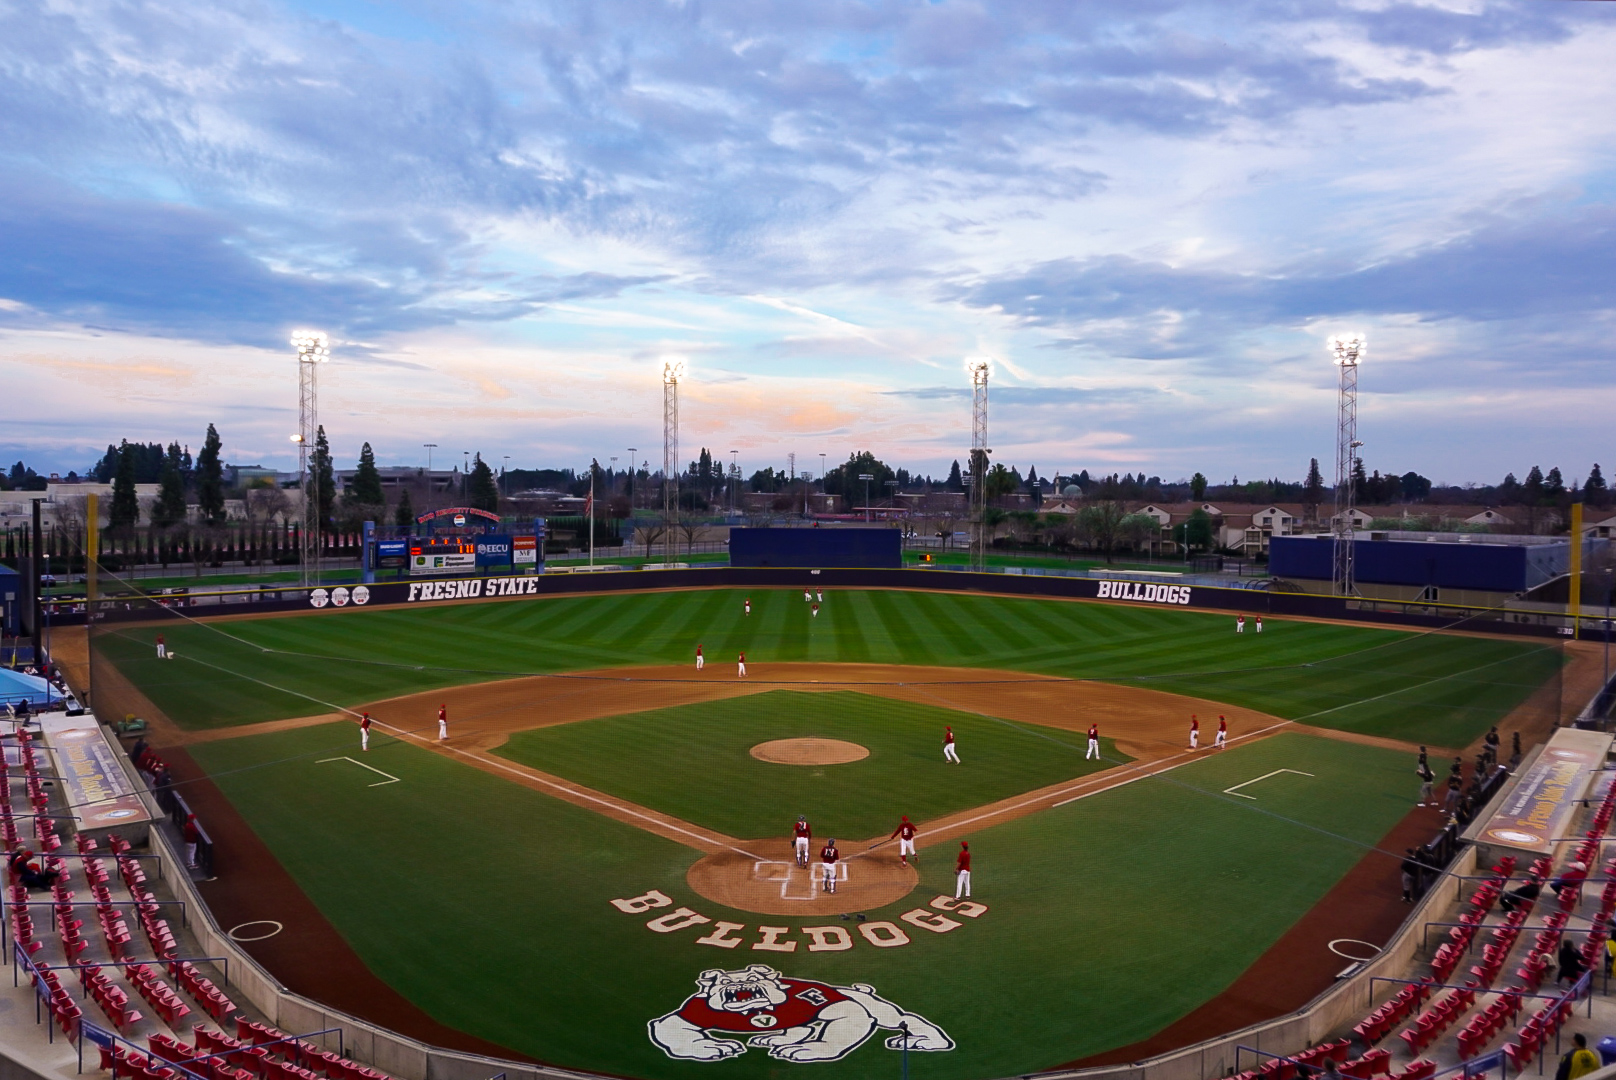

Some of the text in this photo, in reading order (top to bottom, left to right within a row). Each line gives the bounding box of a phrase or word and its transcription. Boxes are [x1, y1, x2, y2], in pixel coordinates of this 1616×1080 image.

[486, 544, 508, 553] EECU
[408, 577, 539, 602] FRESNO STATE
[1096, 580, 1192, 605] BULLDOGS
[610, 889, 989, 952] BULLDOGS
